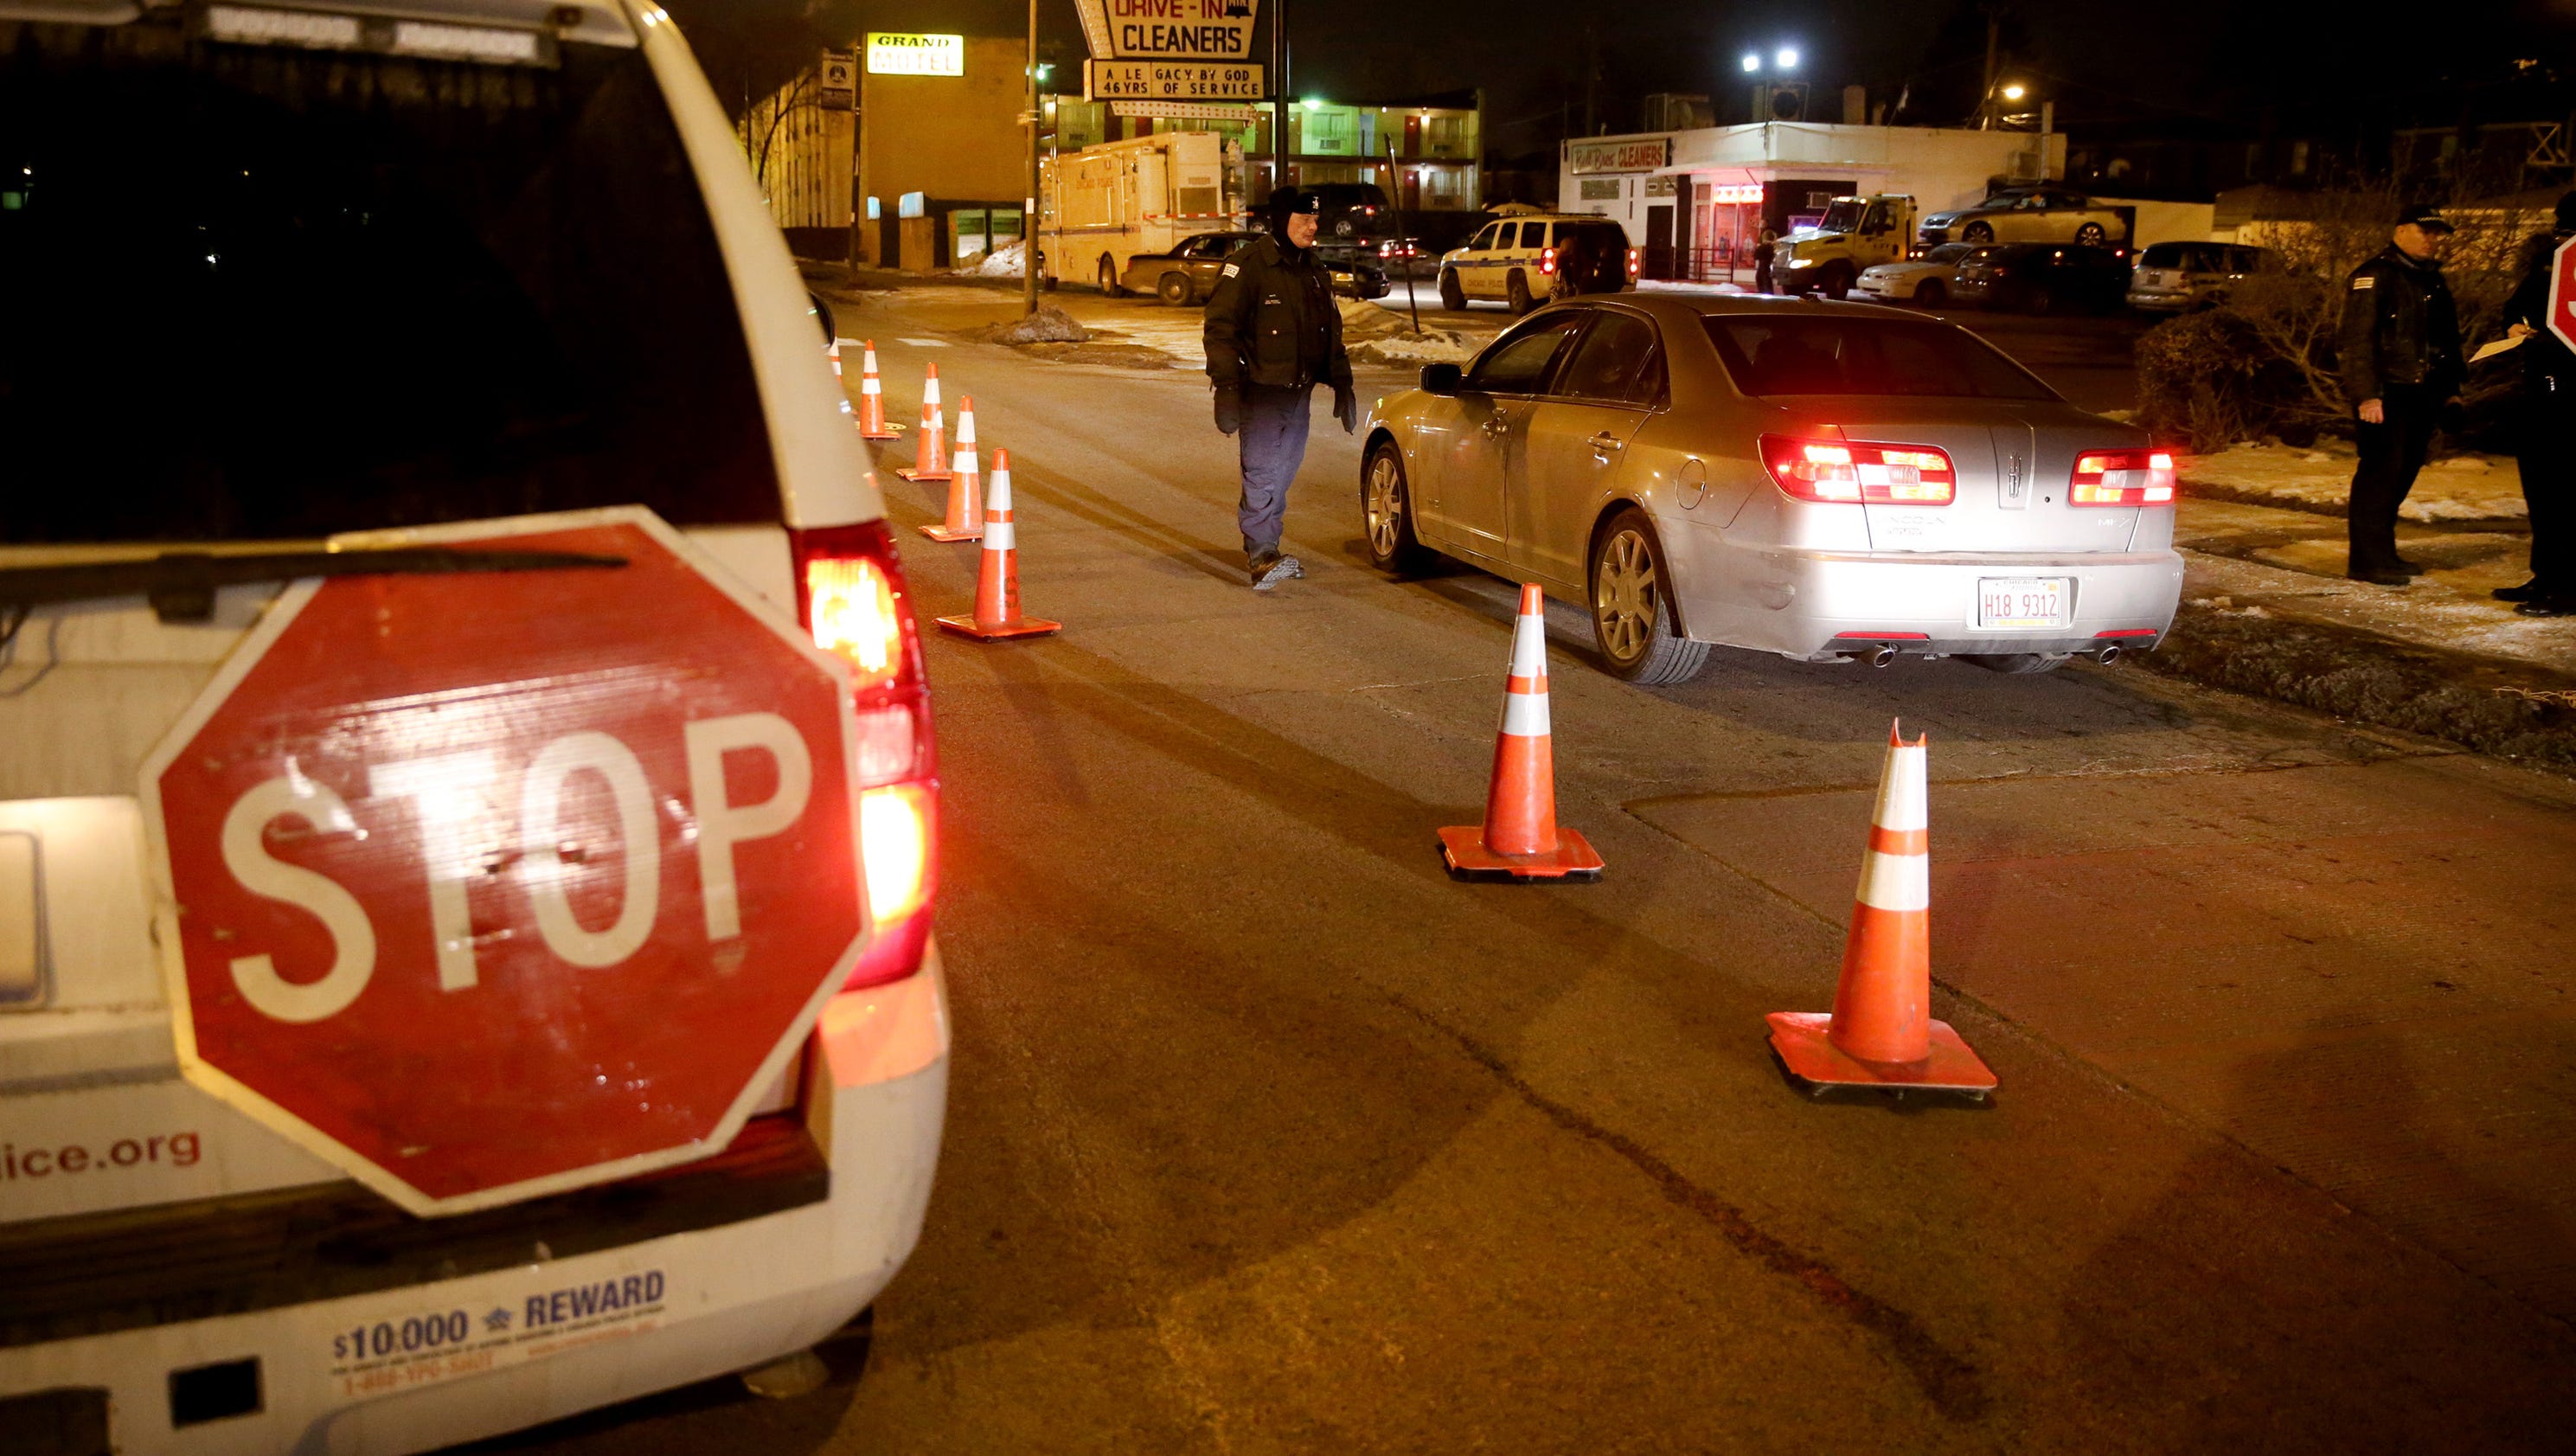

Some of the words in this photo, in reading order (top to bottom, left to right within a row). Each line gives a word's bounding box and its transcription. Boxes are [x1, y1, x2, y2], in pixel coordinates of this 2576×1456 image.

[877, 35, 950, 48] GRAND
[1123, 24, 1242, 53] CLEANERS
[1105, 68, 1113, 80] A
[1200, 69, 1216, 80] BY
[1225, 70, 1250, 81] GOD
[1163, 83, 1179, 94] OF
[1190, 83, 1259, 95] SERVICE
[1618, 144, 1663, 167] CLEANERS
[1984, 593, 2011, 617] H18
[2022, 593, 2058, 617] 9312
[221, 711, 812, 1023] STOP
[0, 1132, 201, 1180] ice.org
[525, 1270, 664, 1328] REWARD
